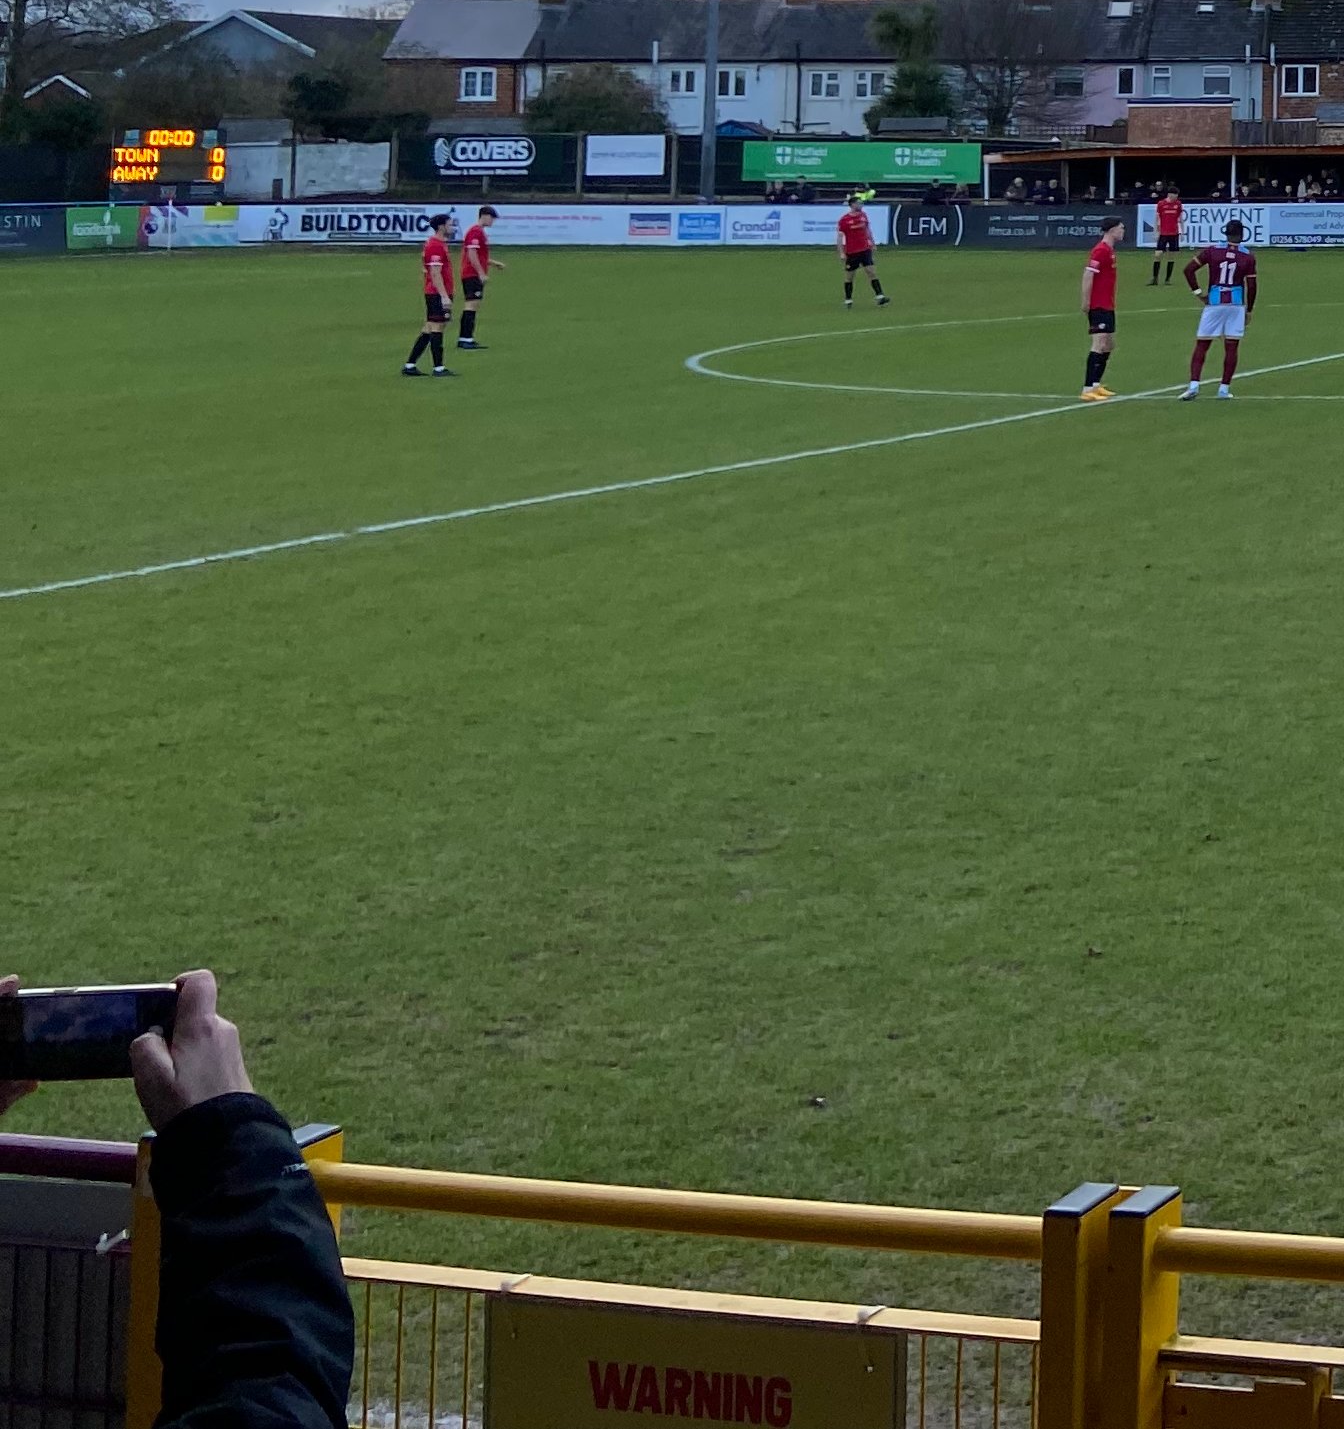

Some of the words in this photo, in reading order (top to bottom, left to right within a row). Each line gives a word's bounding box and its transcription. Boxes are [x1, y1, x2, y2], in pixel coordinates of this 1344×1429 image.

[149, 129, 195, 146] 00:00
[114, 147, 159, 163] TOWN
[212, 147, 225, 163] 0
[455, 140, 529, 160] COVERS
[112, 165, 158, 181] AWAY
[212, 165, 225, 181] 0
[301, 214, 430, 232] BUILDTONIC
[1182, 225, 1265, 243] HILLSDE
[1219, 260, 1237, 285] 11
[588, 1359, 793, 1429] WARNING
